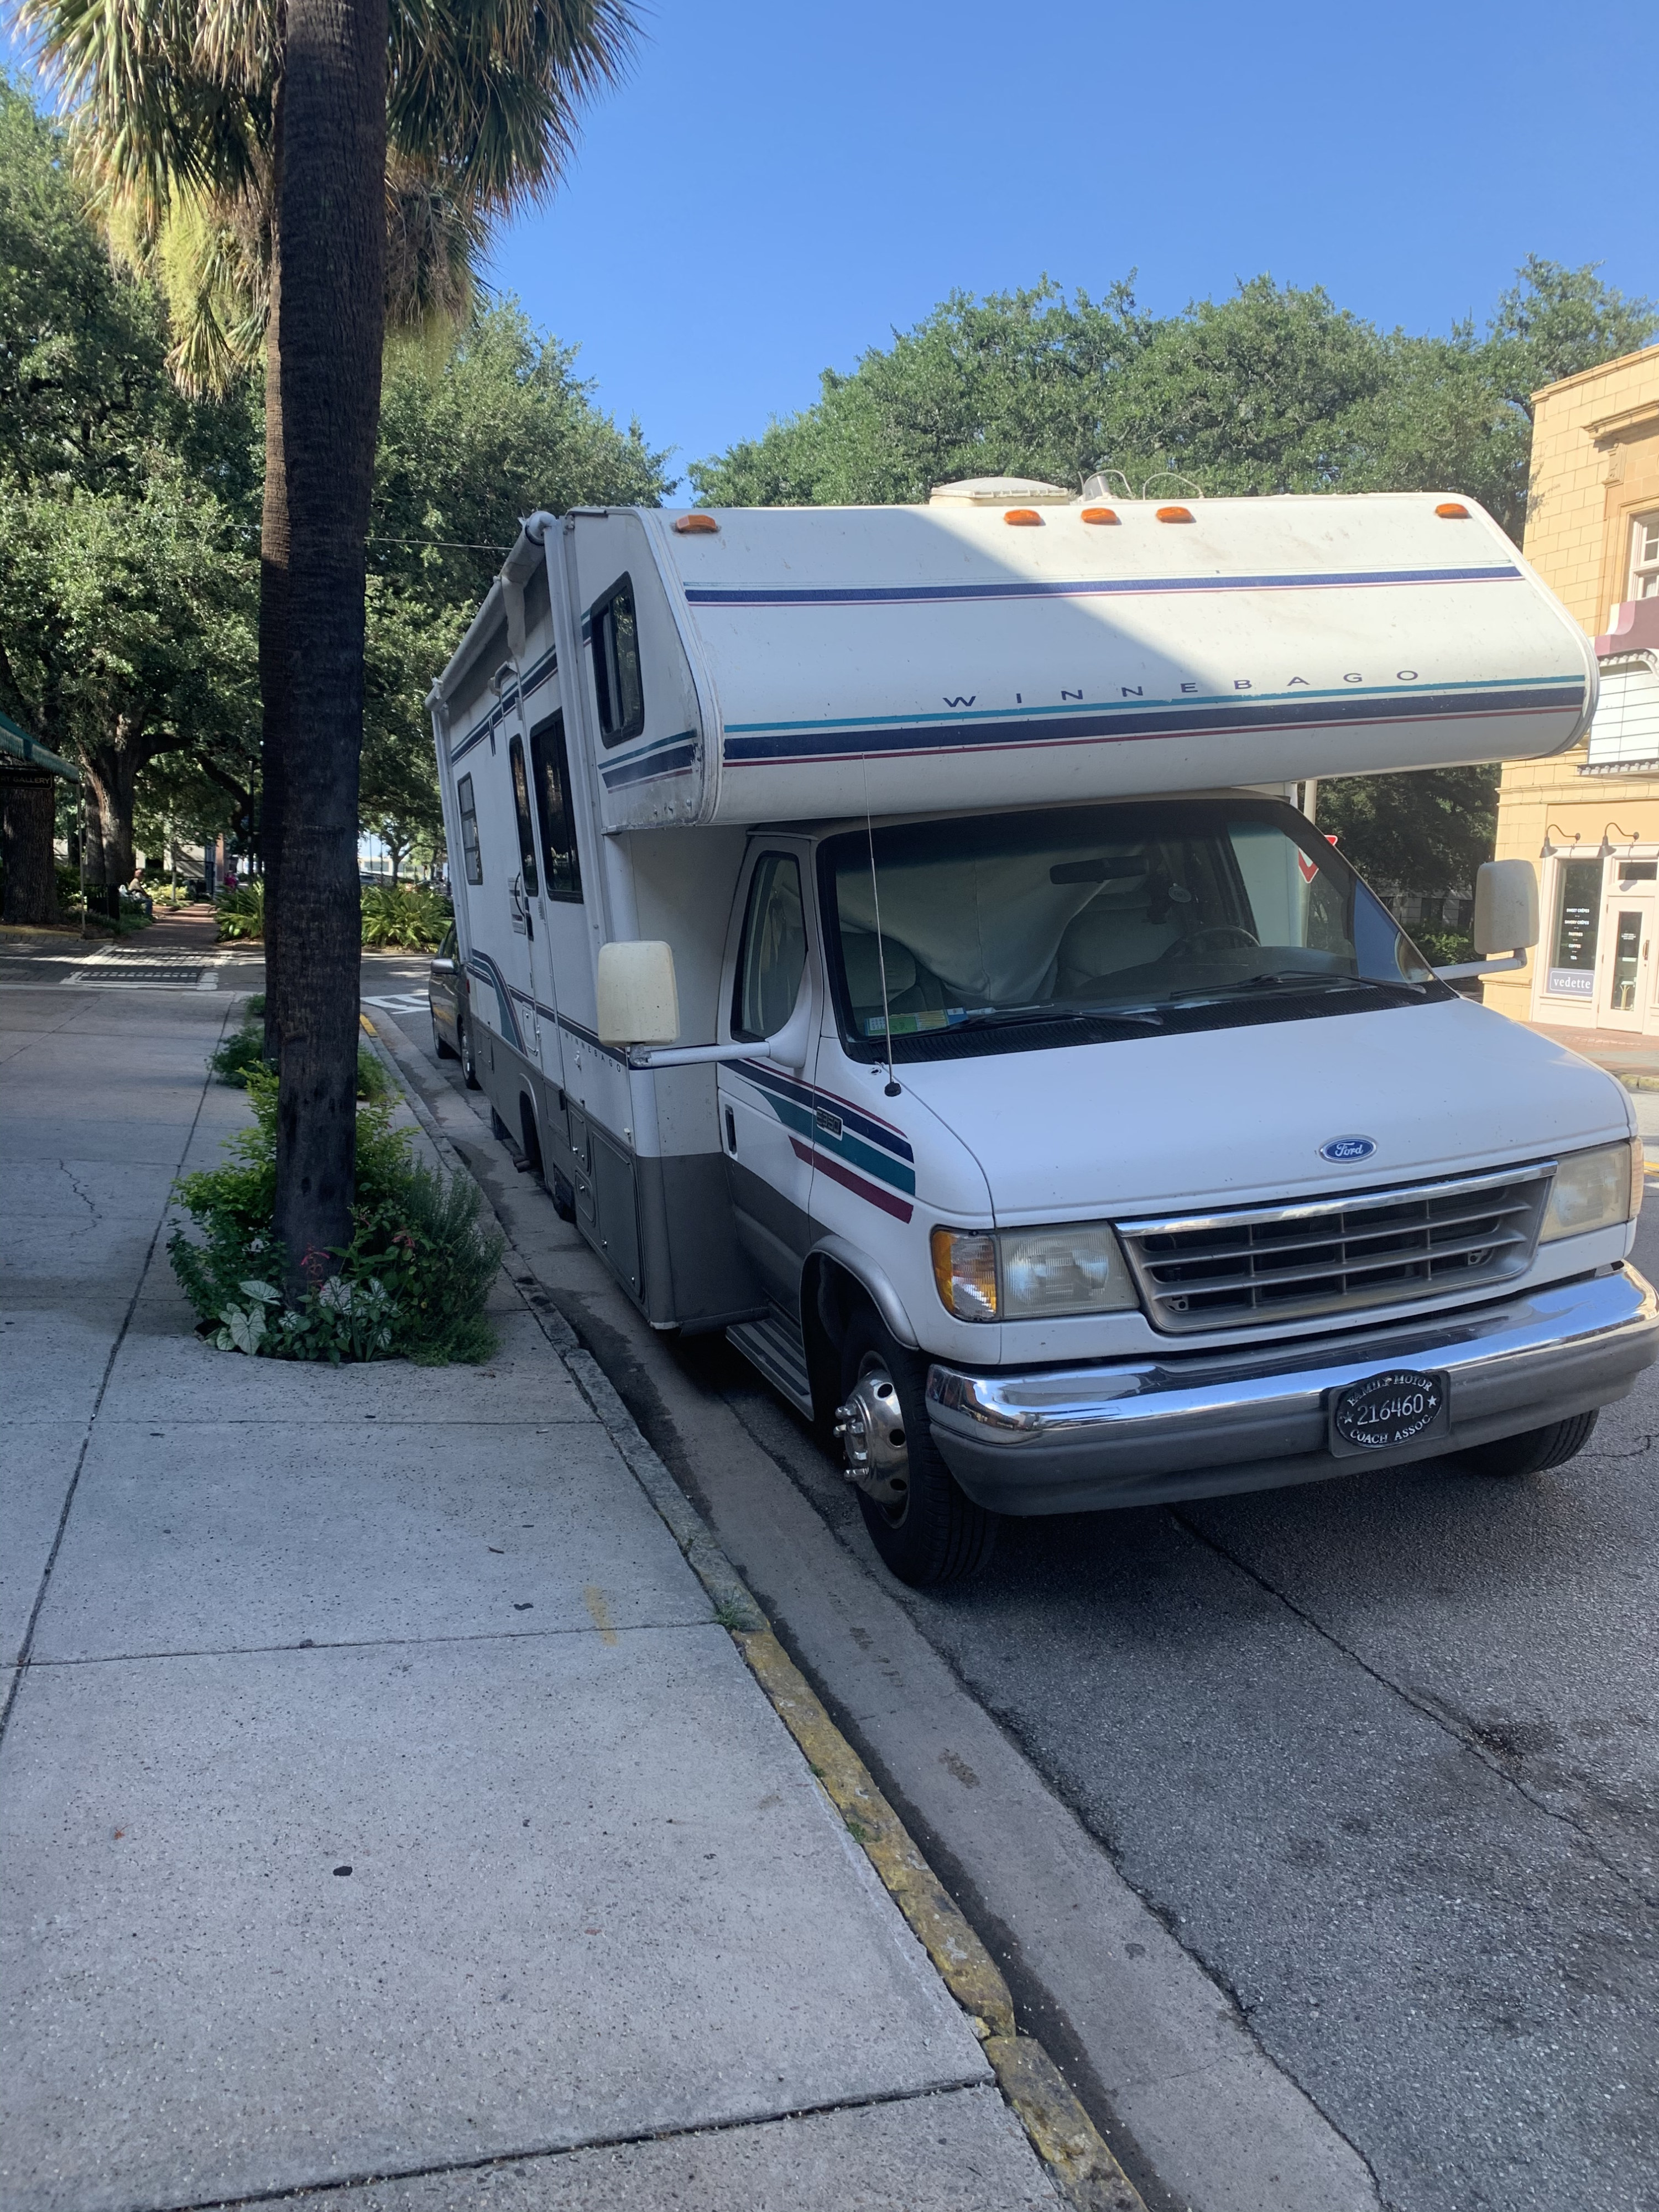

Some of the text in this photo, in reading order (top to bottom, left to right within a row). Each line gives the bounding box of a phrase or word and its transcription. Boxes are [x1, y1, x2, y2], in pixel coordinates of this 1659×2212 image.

[942, 670, 1418, 707] WINNEBAGO
[1553, 977, 1590, 989] vedette
[565, 1031, 620, 1073] WINNEBAGO
[1334, 1142, 1364, 1157] Ford
[1347, 1374, 1432, 1406] FAMILY MOTOR
[1357, 1394, 1423, 1425] 216460
[1350, 1414, 1433, 1444] COACH ASSOC.
